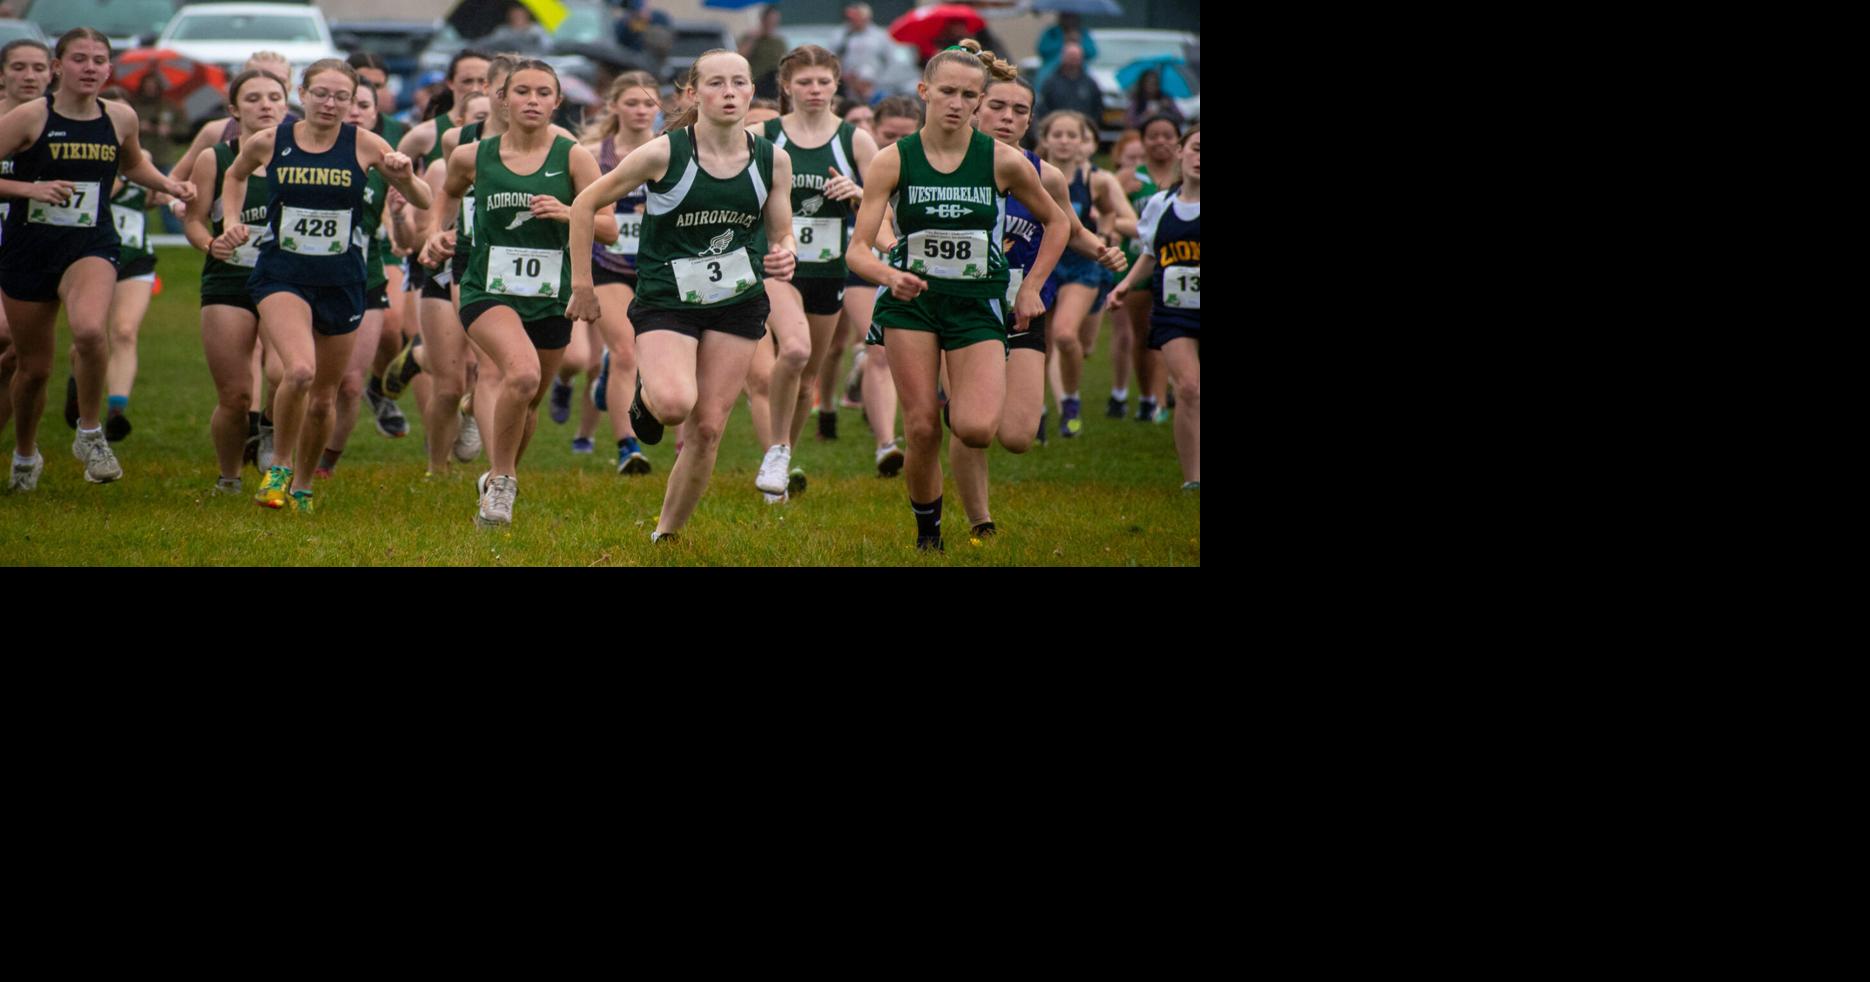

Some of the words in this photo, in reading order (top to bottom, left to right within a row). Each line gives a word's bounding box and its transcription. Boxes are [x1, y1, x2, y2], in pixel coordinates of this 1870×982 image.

[48, 142, 117, 162] VIKINGS
[276, 167, 352, 187] VIKINGS
[908, 185, 992, 206] WESTMORELAND
[294, 218, 337, 237] 428
[800, 226, 813, 244] 8
[924, 239, 972, 260] 598
[512, 257, 541, 278] 10
[706, 261, 723, 282] 3
